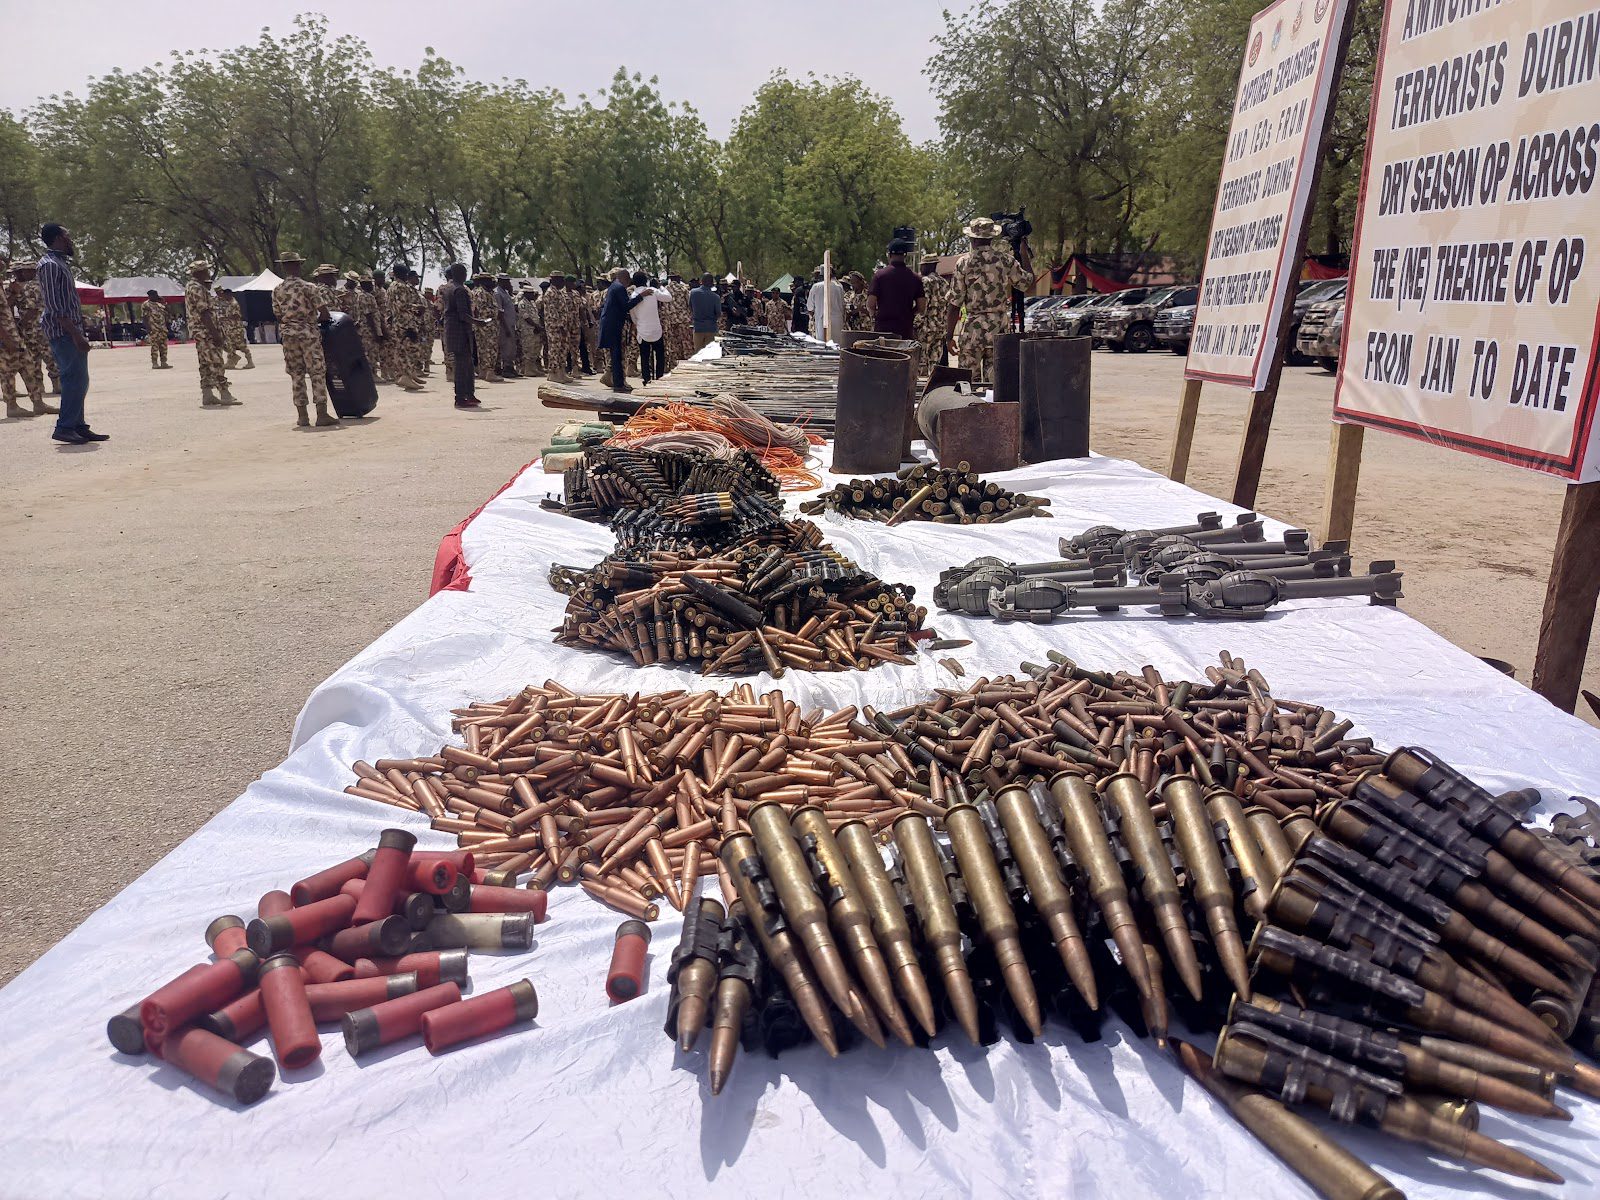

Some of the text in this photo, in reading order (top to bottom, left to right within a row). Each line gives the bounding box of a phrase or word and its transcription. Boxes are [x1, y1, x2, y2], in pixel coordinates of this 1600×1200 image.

[1239, 38, 1320, 114] CAPTURED EXPLOSIVES
[1391, 41, 1508, 130] TERRORISTS
[1518, 10, 1600, 98] DURIN
[1228, 97, 1308, 163] AND IEDs FROM
[1220, 156, 1295, 212] TERRORISTS DURING
[1378, 123, 1600, 216] DRY SEASON OP ACROSS
[1210, 213, 1283, 259] DRY SEASON OP ACROSS
[1202, 269, 1272, 312] THE (NE) THEATRE OF OP
[1370, 238, 1585, 312] THE (NE) THEATRE OF OP
[1193, 324, 1260, 357] FROM JAN TO DATE
[1364, 331, 1577, 412] FROM JAN TO DATE
